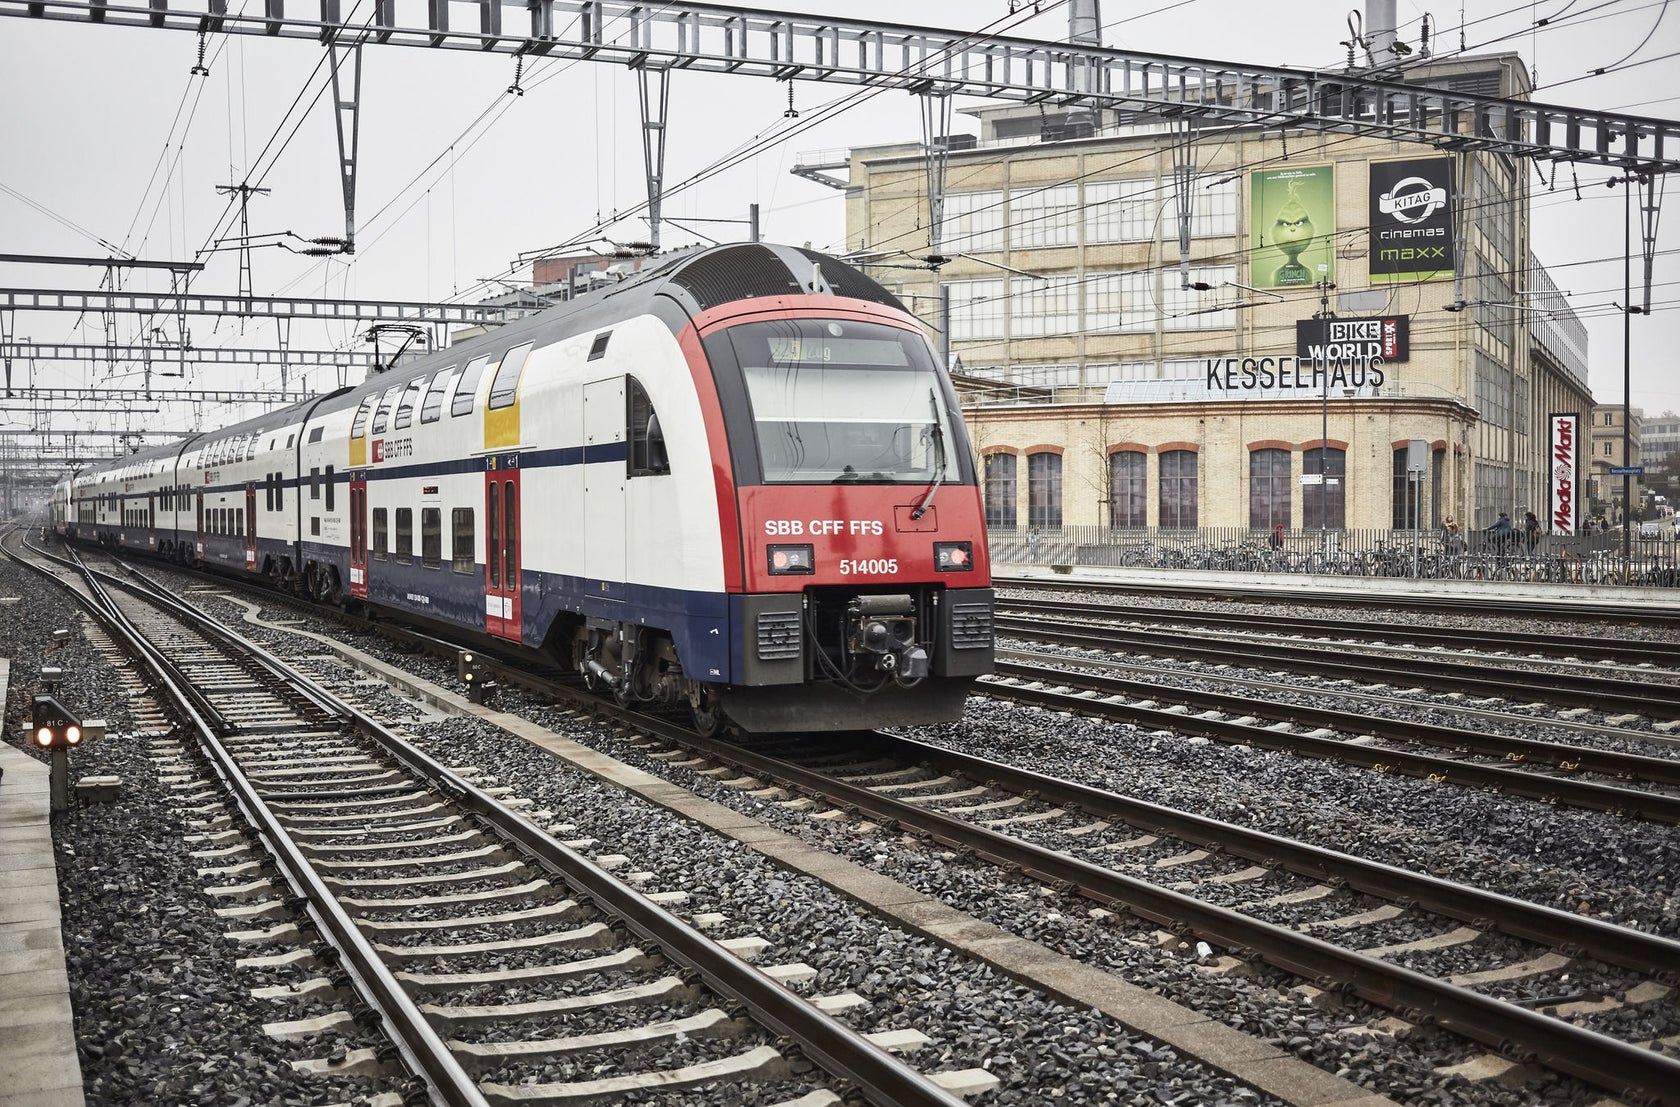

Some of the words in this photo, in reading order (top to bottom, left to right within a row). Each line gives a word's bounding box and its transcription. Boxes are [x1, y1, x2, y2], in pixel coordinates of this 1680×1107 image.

[1394, 192, 1431, 209] KITAG
[1380, 227, 1445, 239] cinemas
[1380, 246, 1445, 261] maxx
[1333, 323, 1378, 340] BIKE
[1308, 342, 1382, 360] WORLD
[1207, 356, 1385, 390] KESSELHAUS
[1554, 418, 1572, 469] Markt
[1554, 479, 1572, 535] Media
[765, 520, 804, 535] SBB
[809, 520, 844, 535] CFF
[849, 520, 883, 535] FFS
[839, 559, 898, 575] 514005
